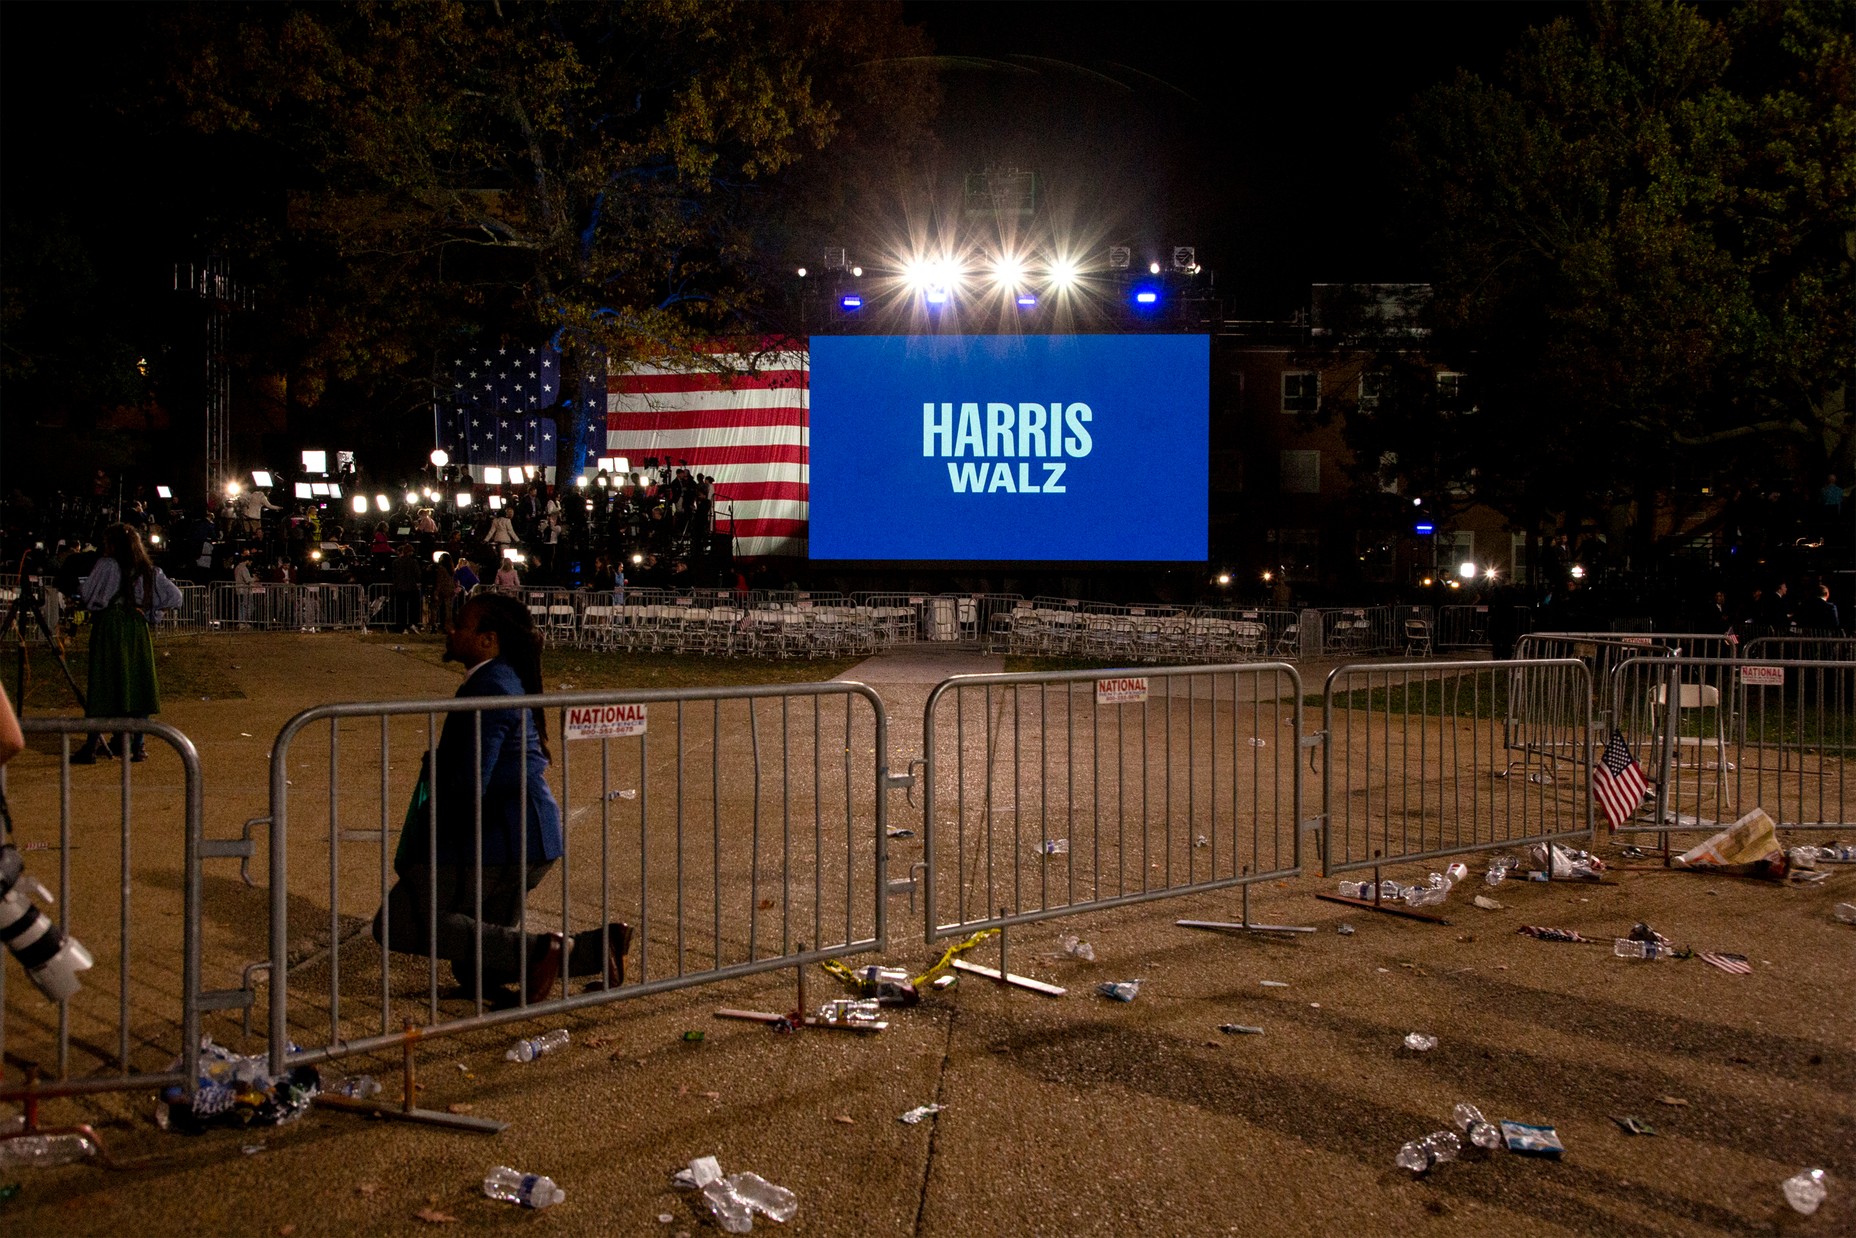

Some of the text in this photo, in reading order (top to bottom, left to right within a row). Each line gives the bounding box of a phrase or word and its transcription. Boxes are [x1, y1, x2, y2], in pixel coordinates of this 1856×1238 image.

[923, 402, 1093, 458] HARRIS
[947, 462, 1067, 493] WALZ
[1742, 667, 1782, 677] NATIONAL
[1099, 679, 1147, 692] NATIONAL
[570, 705, 645, 725] NATIONAL
